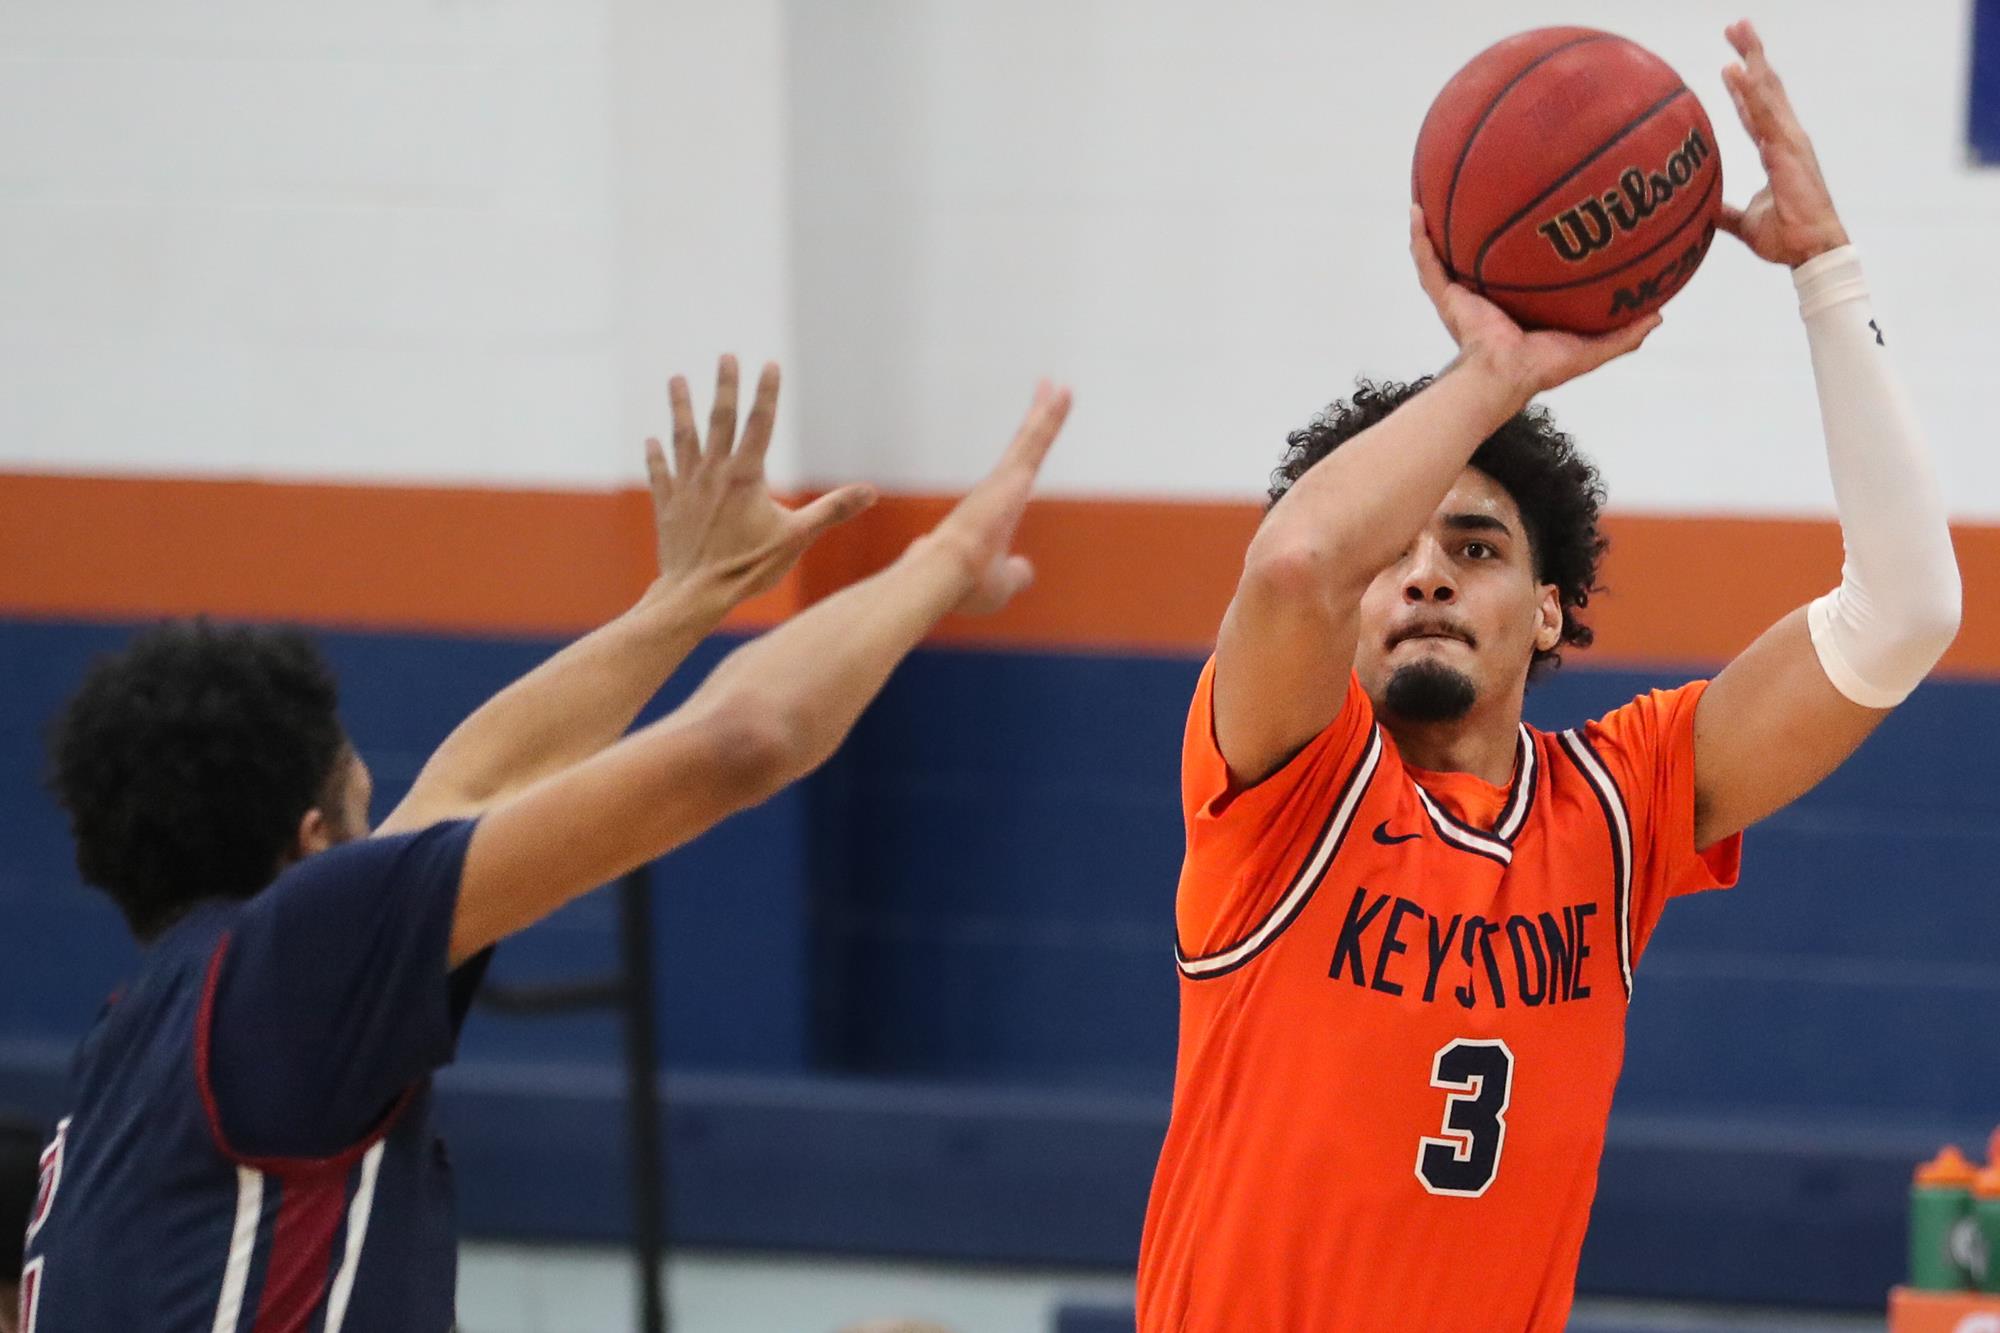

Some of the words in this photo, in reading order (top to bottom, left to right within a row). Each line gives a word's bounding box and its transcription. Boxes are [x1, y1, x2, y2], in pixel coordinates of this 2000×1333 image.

[1537, 127, 1709, 262] Wilson
[1328, 886, 1597, 1009] KEYSTONE
[1414, 1037, 1515, 1198] 3
